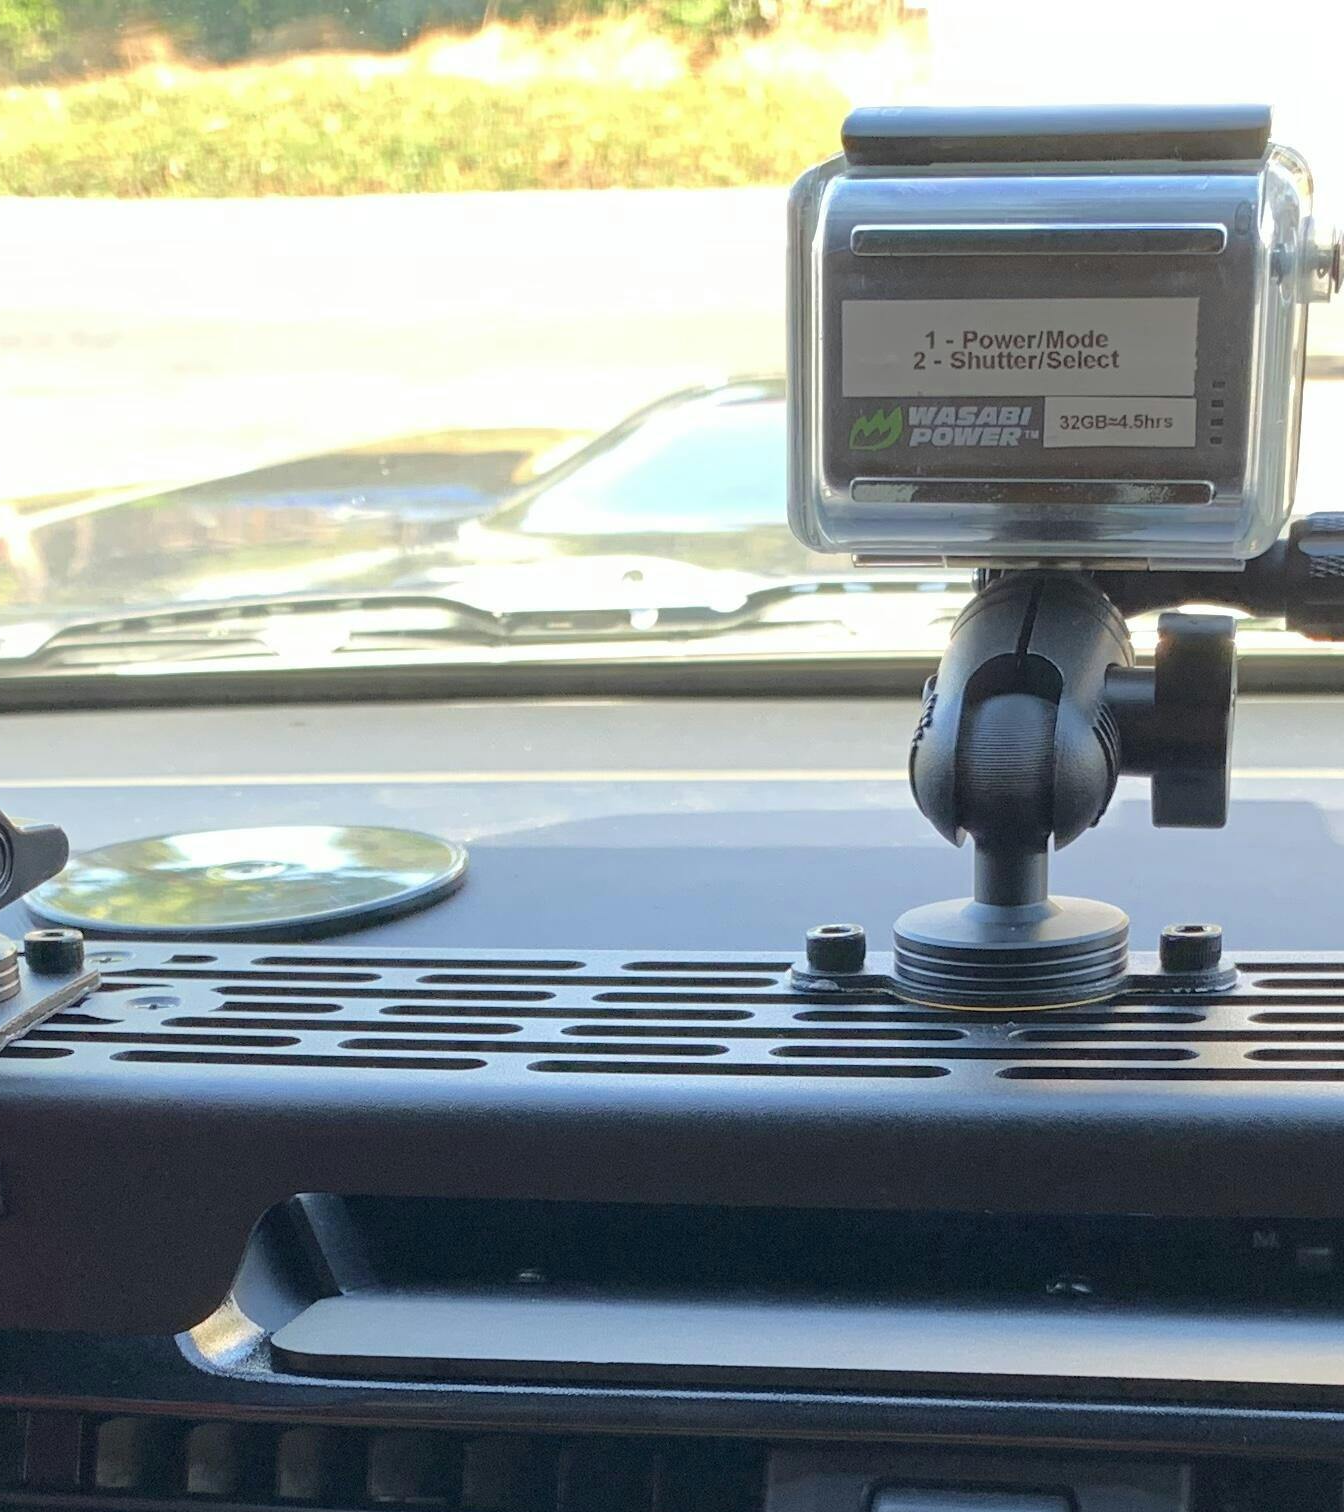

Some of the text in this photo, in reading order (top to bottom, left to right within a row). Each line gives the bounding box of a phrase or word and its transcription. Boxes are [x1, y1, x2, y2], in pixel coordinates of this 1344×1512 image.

[925, 330, 937, 349] 1
[962, 329, 1109, 351] Power/Mode
[913, 351, 927, 371] 2
[950, 350, 1121, 371] Shutter/Select
[908, 406, 1032, 427] WASABI
